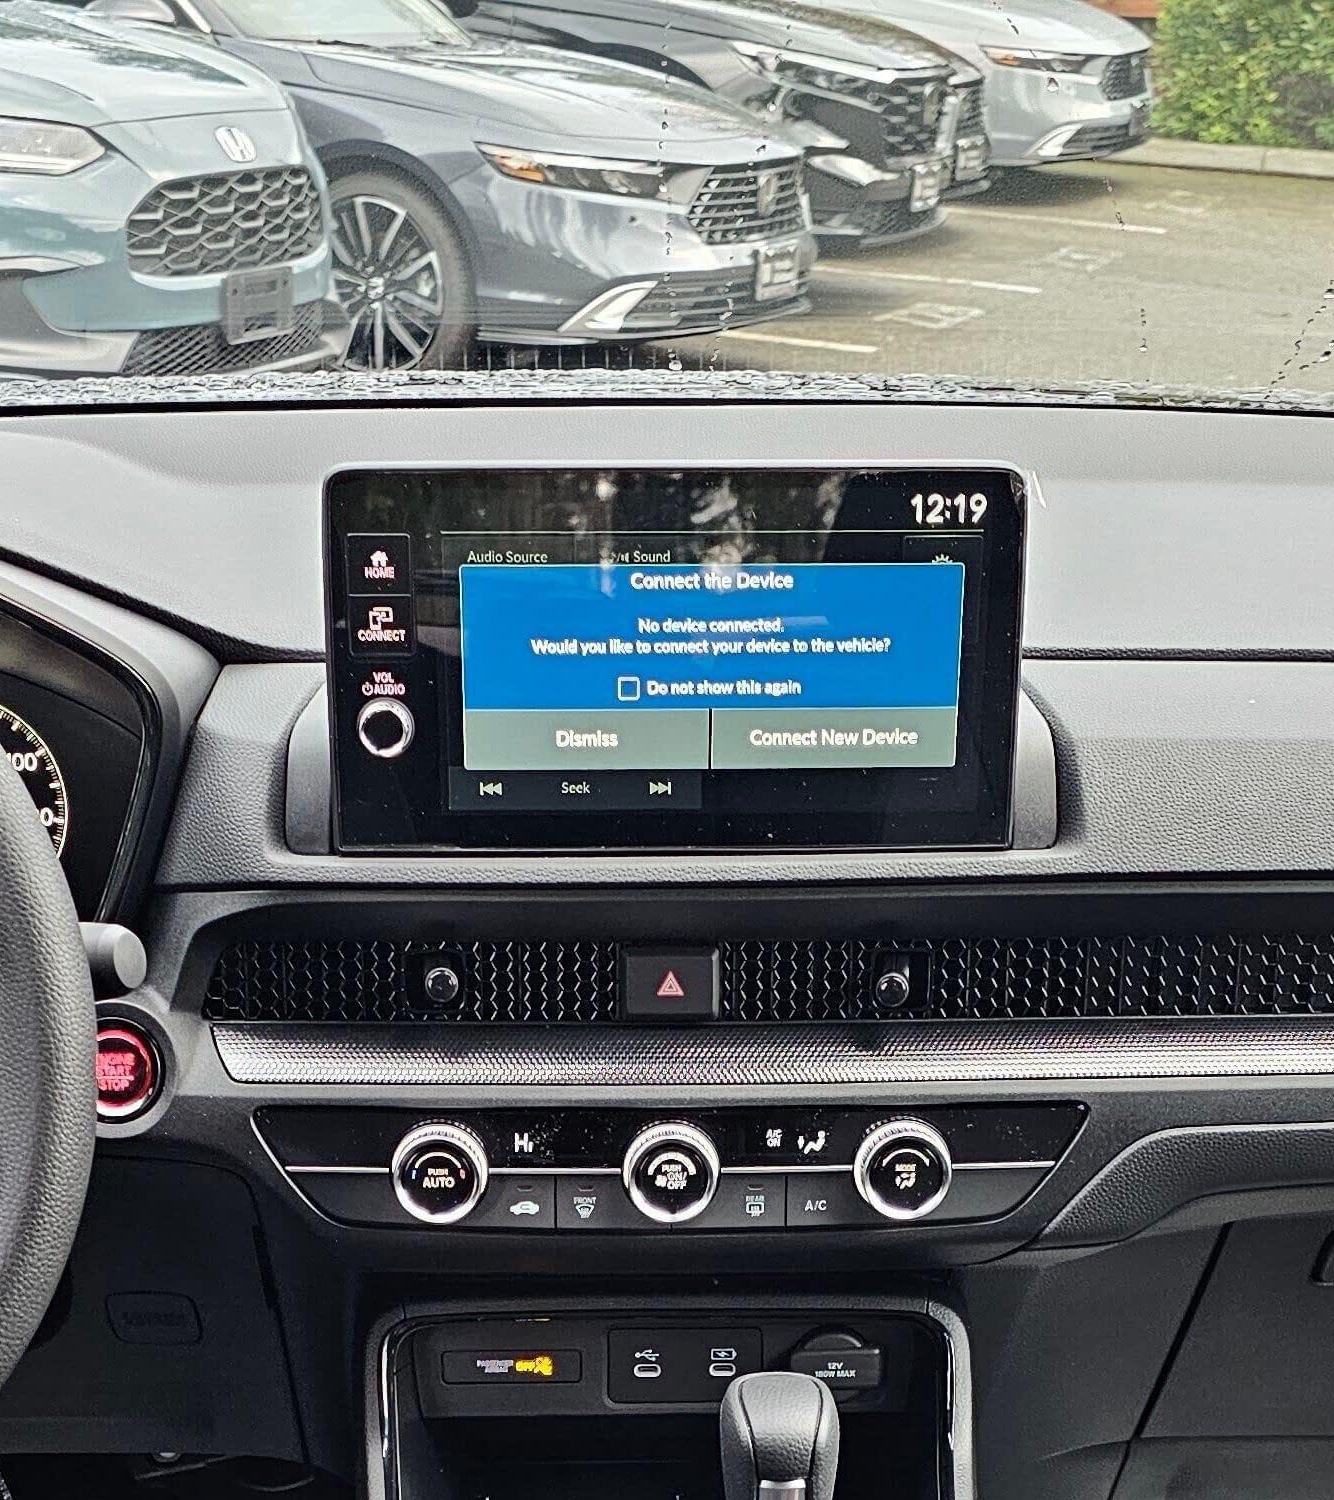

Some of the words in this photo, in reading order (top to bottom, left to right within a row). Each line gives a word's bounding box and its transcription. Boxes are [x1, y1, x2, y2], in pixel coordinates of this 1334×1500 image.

[910, 492, 988, 525] 12:19
[467, 550, 503, 564] Audio
[506, 551, 548, 564] Source
[633, 550, 671, 563] Sound
[364, 566, 395, 579] HOME
[630, 573, 700, 590] Connect
[704, 572, 732, 589] the
[736, 572, 794, 589] Device
[638, 618, 661, 633] No
[662, 617, 708, 633] device
[709, 617, 785, 633] connected.
[357, 629, 406, 642] CONNECT
[531, 639, 578, 654] Would
[581, 641, 606, 656] you
[608, 639, 634, 654] like
[636, 640, 652, 654] to
[654, 640, 710, 654] connect
[712, 640, 744, 656] your
[746, 638, 790, 653] device
[793, 639, 808, 653] to
[811, 638, 835, 652] the
[836, 637, 892, 653] vehicle?
[373, 672, 395, 684] VOL
[374, 683, 406, 695] AUDIO
[647, 681, 668, 696] Do
[670, 681, 694, 696] not
[696, 680, 734, 696] show
[736, 680, 761, 695] this
[765, 680, 802, 697] again
[555, 730, 618, 747] Dismiss
[750, 729, 818, 746] Connect
[821, 729, 859, 746] New
[862, 728, 918, 746] Device
[561, 782, 591, 795] Seek
[96, 1065, 132, 1076] START
[98, 1079, 130, 1091] STOP
[766, 1138, 781, 1148] ON
[661, 1164, 682, 1172] PUSH
[422, 1177, 456, 1188] AUTO
[667, 1180, 688, 1190] OFF
[573, 1197, 597, 1205] FRONT
[804, 1200, 827, 1211] A/C
[827, 1362, 844, 1370] 12V
[836, 1370, 857, 1378] MAX
